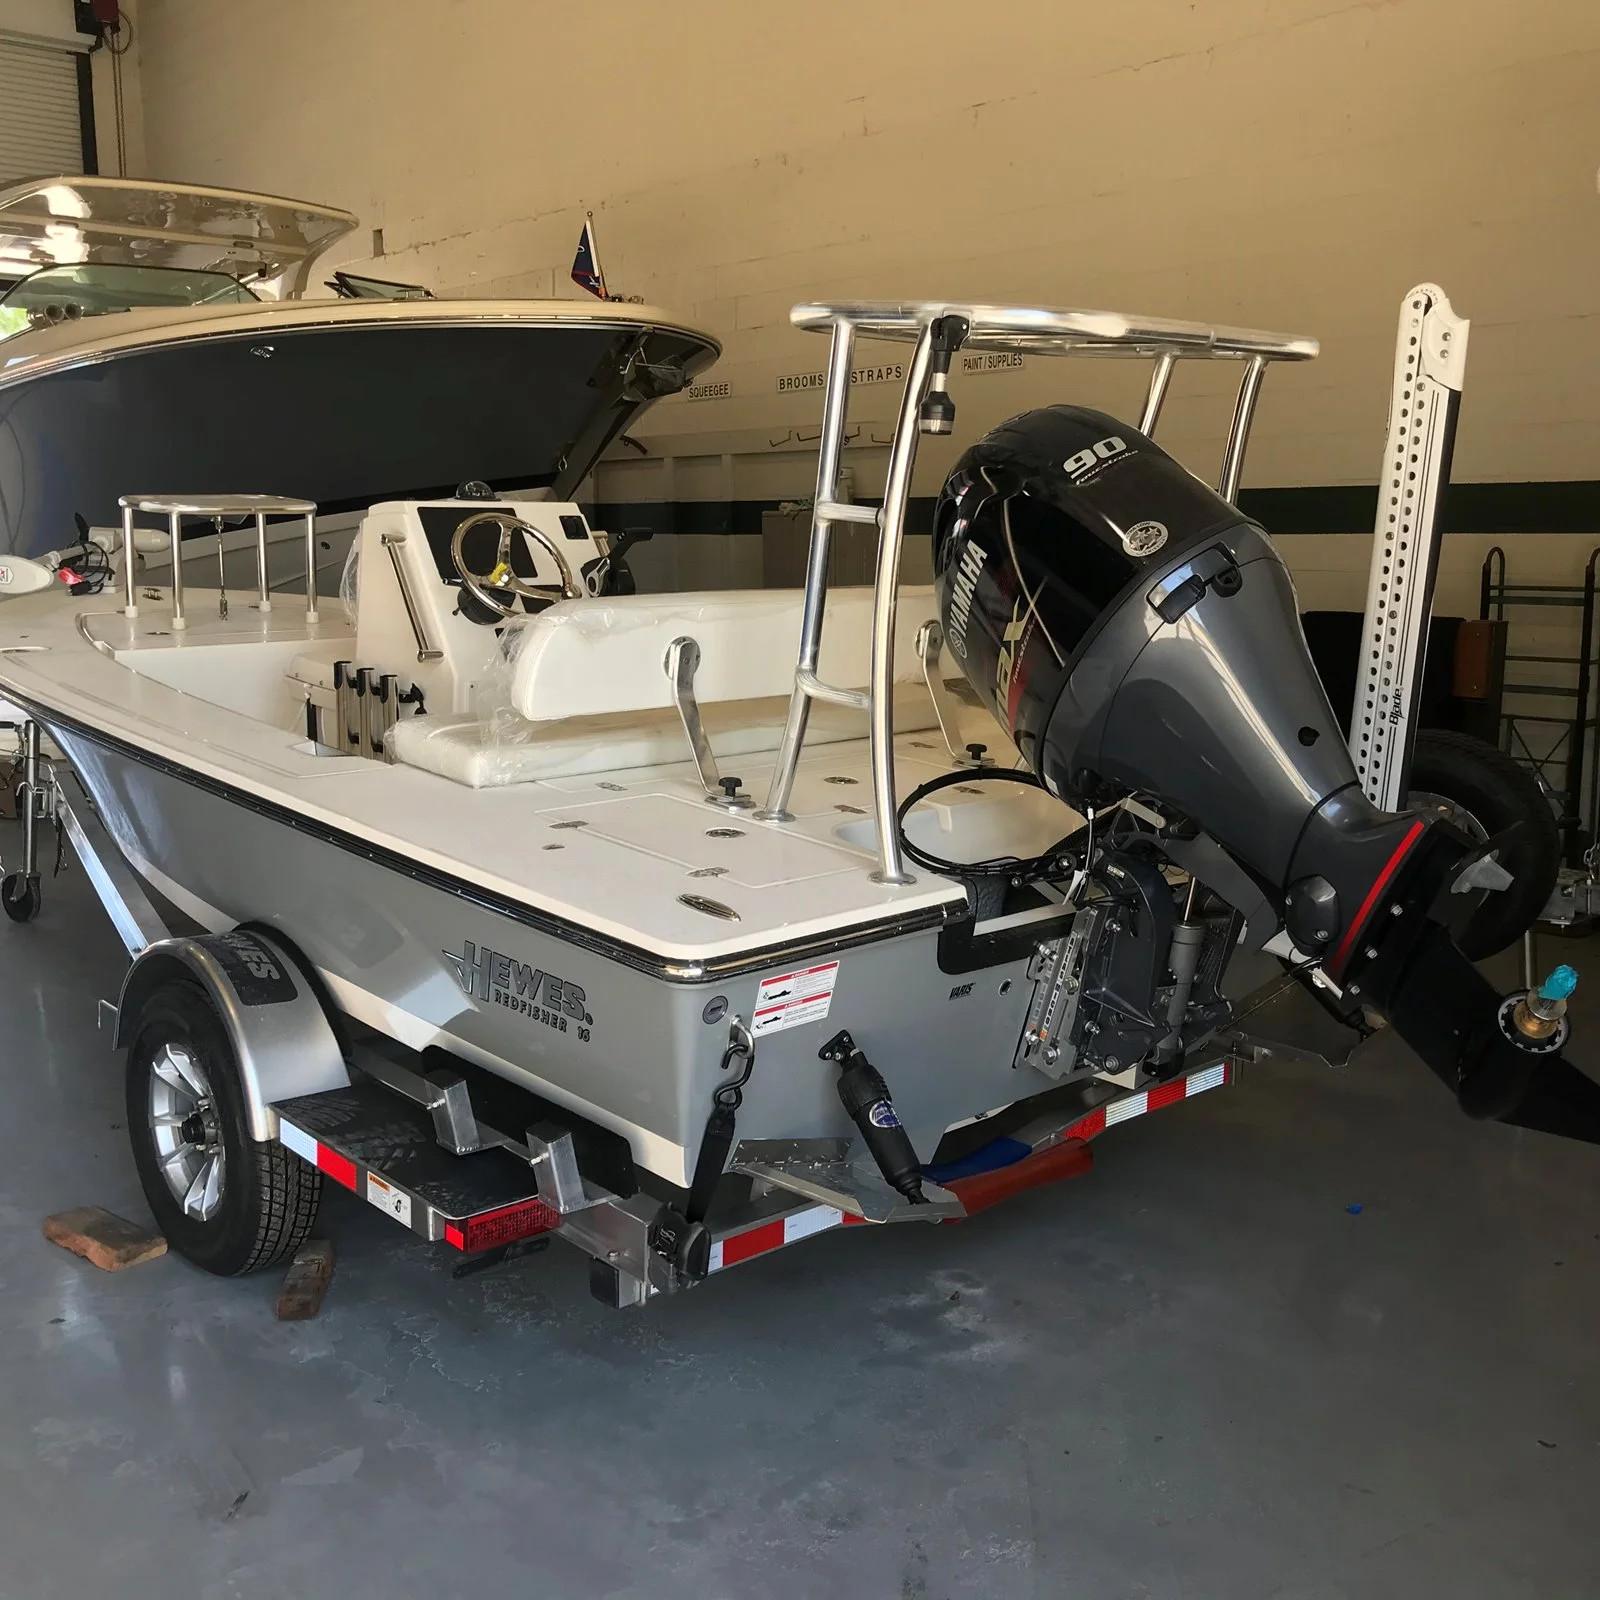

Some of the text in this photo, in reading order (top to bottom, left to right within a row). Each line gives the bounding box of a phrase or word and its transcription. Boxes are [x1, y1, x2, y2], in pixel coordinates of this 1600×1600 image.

[688, 383, 729, 398] SQUEEGEE
[779, 374, 824, 390] BROOMS
[851, 366, 902, 383] STRAPS
[1063, 436, 1127, 479] 90
[950, 539, 988, 639] YAMAHA
[1389, 688, 1405, 726] Blade
[443, 940, 587, 1022] HEWES
[494, 989, 568, 1033] REDFISHER
